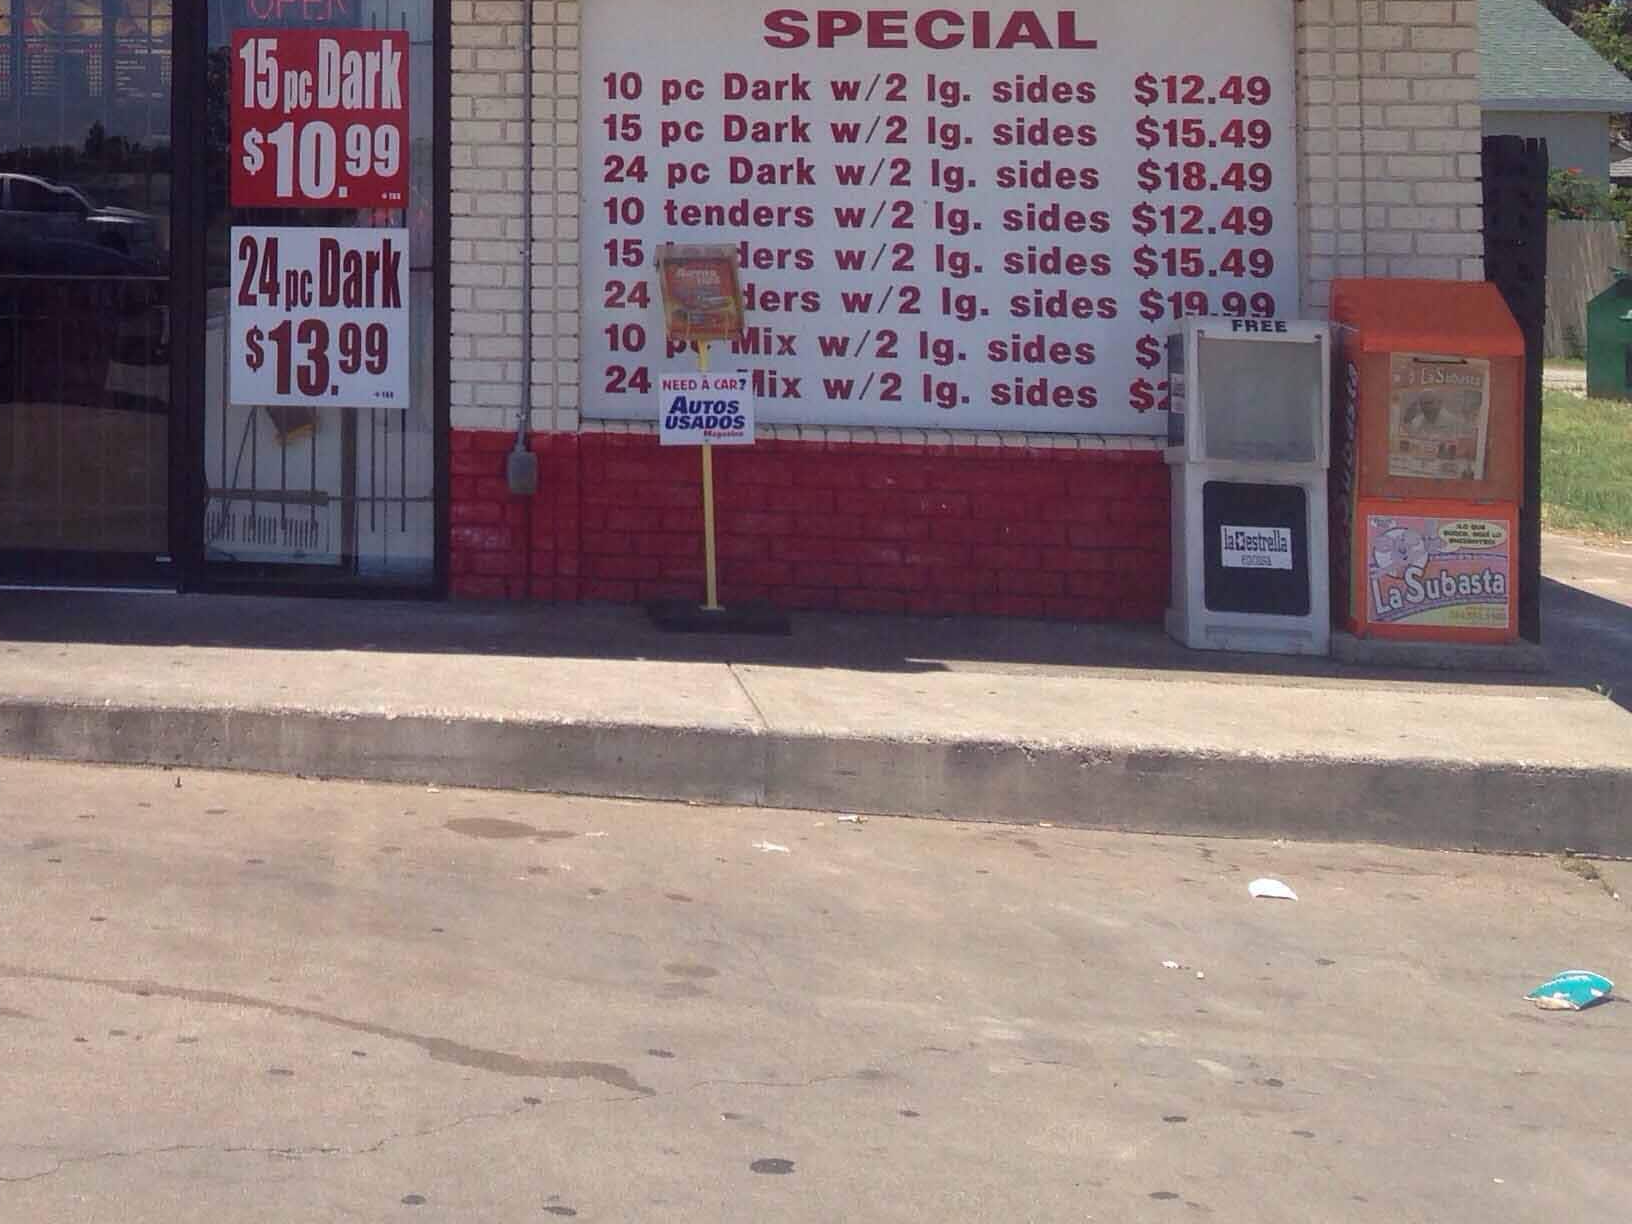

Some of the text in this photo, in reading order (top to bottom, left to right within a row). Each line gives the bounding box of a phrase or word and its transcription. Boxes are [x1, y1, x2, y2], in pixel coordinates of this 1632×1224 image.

[763, 9, 1098, 50] SPECIAL
[239, 38, 278, 110] 15
[283, 68, 313, 114] pc
[319, 39, 402, 111] Dark
[603, 72, 1272, 107] 10 pc Dark w/2 lg. sides $12.49
[603, 114, 1273, 150] 15 pc Dark w/2 lg. sides $15.49
[243, 121, 400, 200] $10.99
[603, 155, 1273, 194] 24 pc Dark w/2 lg. sides $18.49
[603, 197, 1273, 236] 10 tenders w/2 lg. sides $12.49
[238, 235, 402, 312] 24 pc Dark
[603, 238, 644, 267] 15
[834, 243, 915, 273] w/2
[936, 244, 983, 278] lg.
[1004, 246, 1112, 276] sides
[1133, 243, 1274, 279] $15.49
[603, 280, 651, 309] 24
[841, 285, 922, 315] w/2
[942, 287, 989, 321] lg.
[1010, 289, 1118, 320] sides
[1139, 287, 1275, 323] $19.99
[604, 323, 646, 352] 10
[731, 327, 797, 356] Mix
[818, 330, 899, 359] w/2
[919, 331, 967, 366] lg.
[987, 333, 1096, 365] sides
[1231, 319, 1289, 333] FREE
[245, 318, 389, 397] $13.99
[604, 366, 652, 394] 24
[824, 372, 902, 402] w/2
[922, 373, 970, 409] lg.
[990, 377, 1098, 408] sides
[662, 379, 747, 391] NEED A CAR?
[665, 415, 746, 430] USADOS
[1246, 529, 1288, 553] estrella
[1369, 564, 1506, 614] La Subasta
